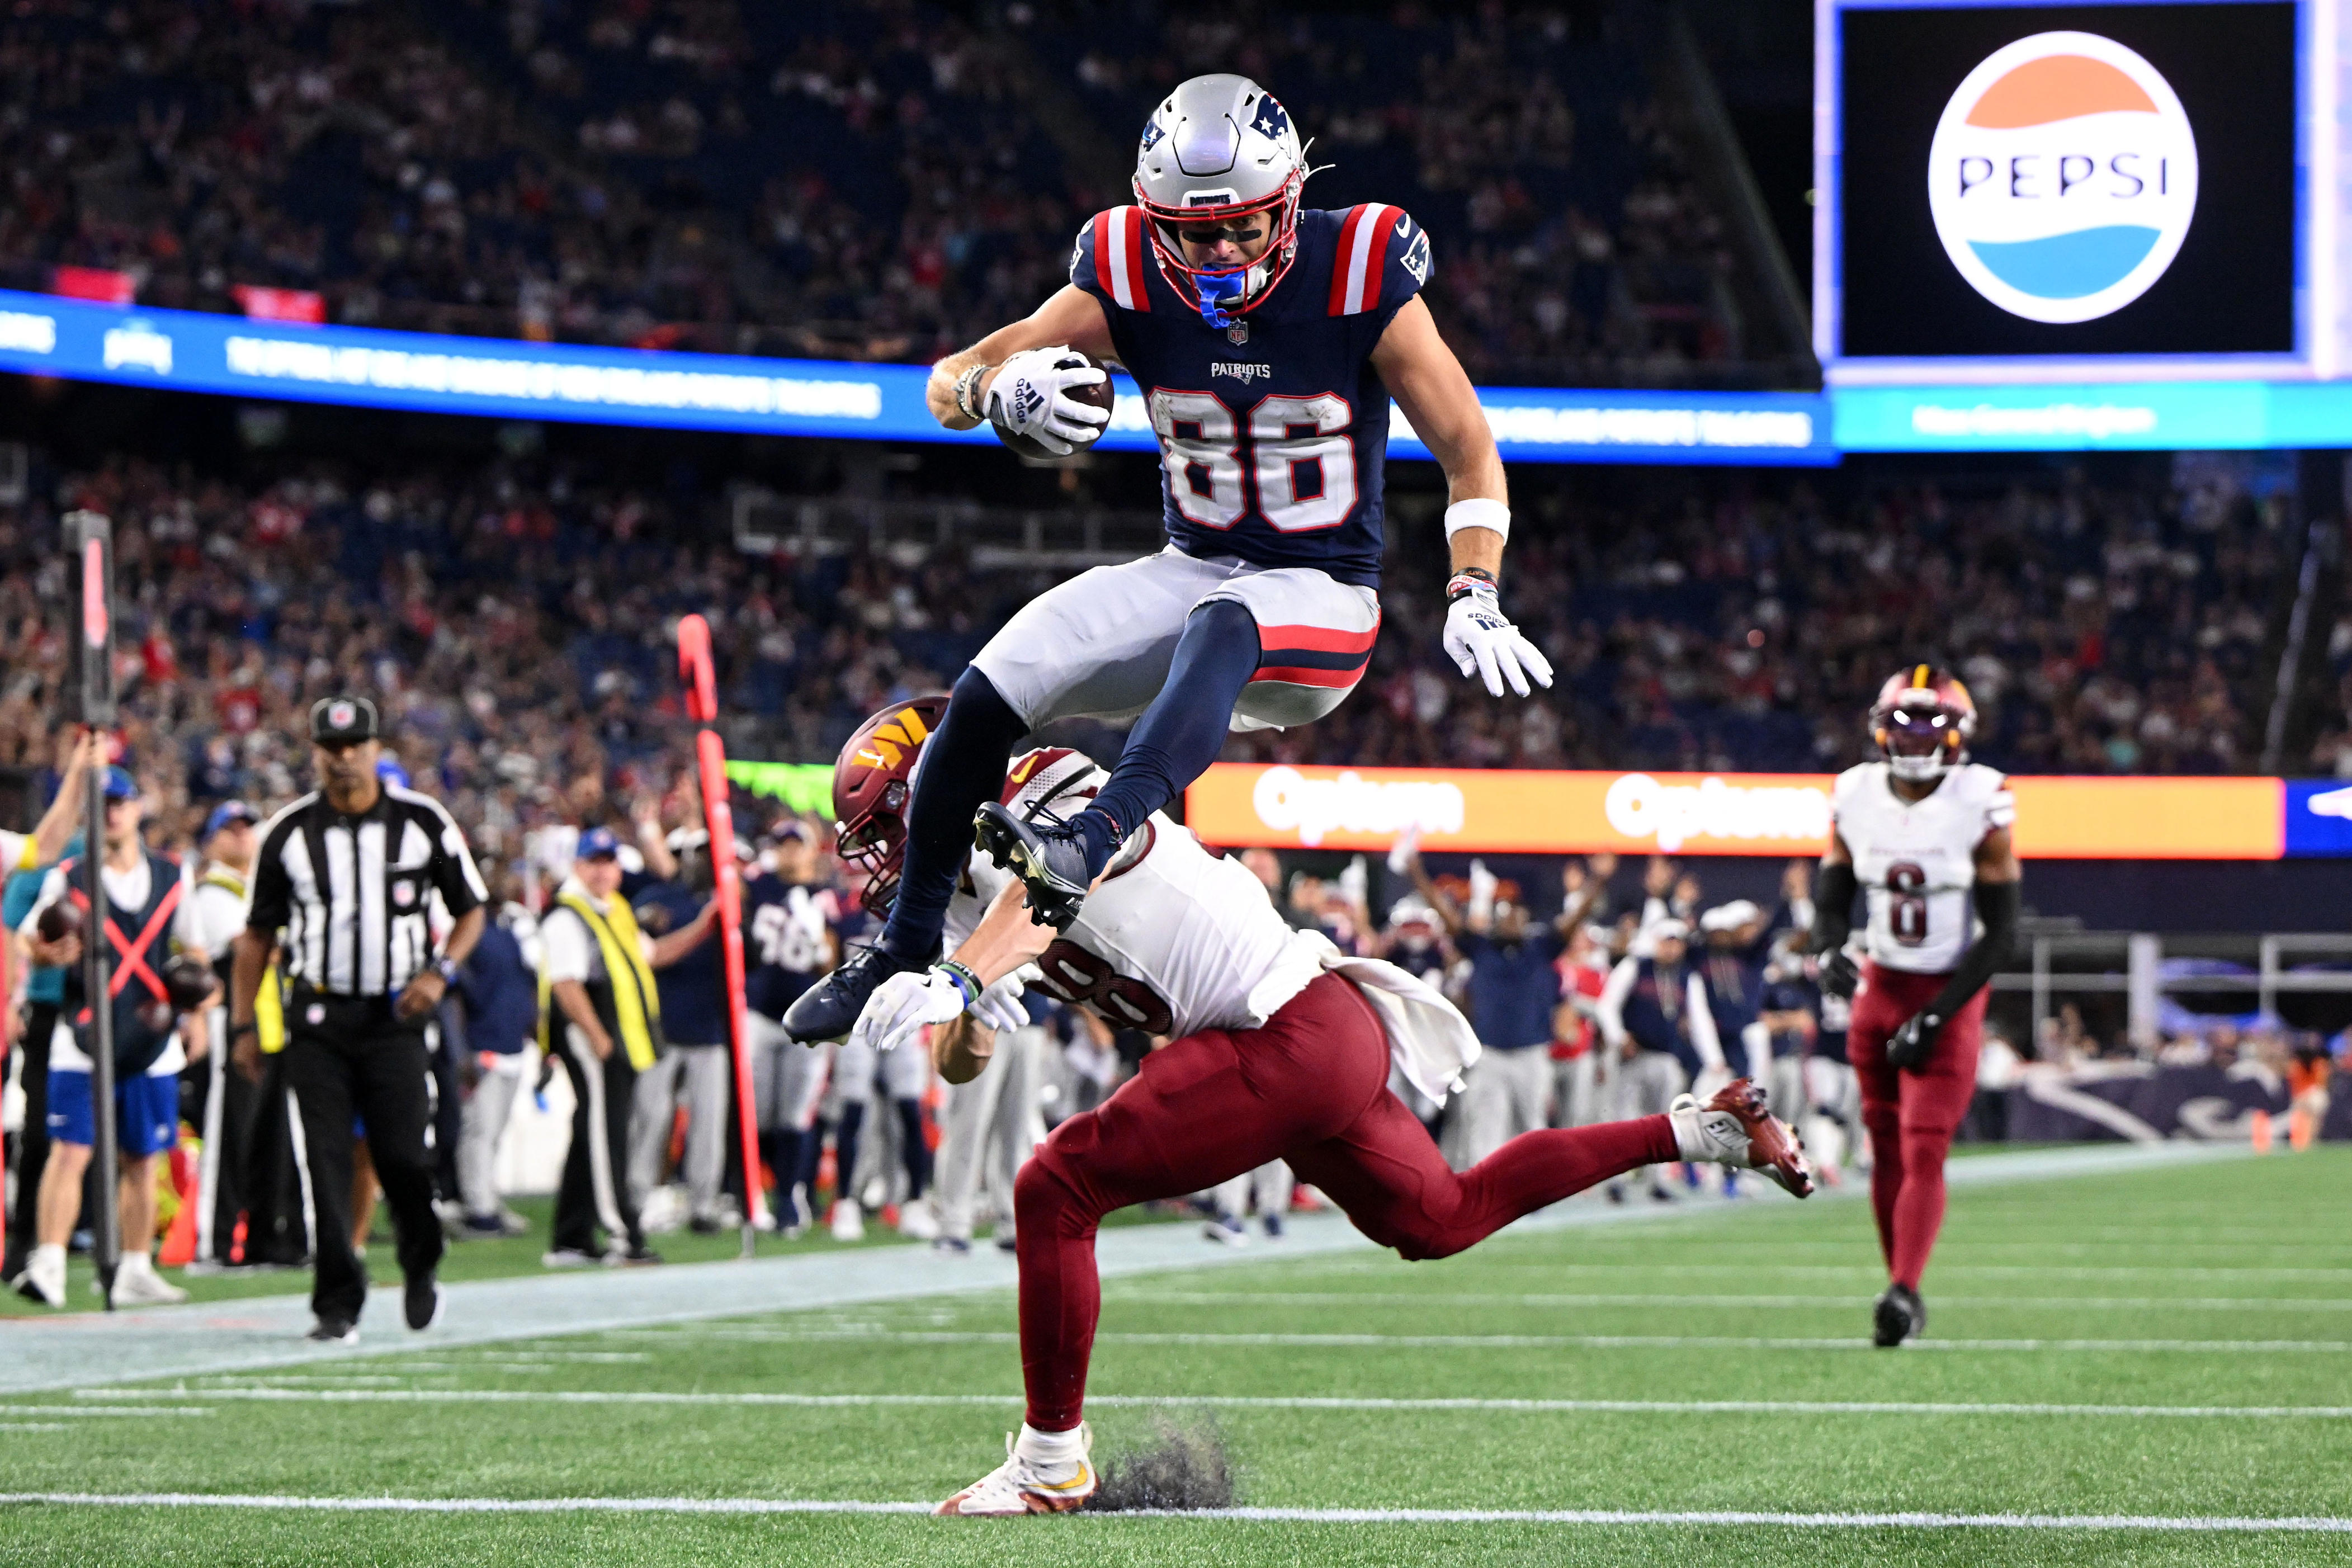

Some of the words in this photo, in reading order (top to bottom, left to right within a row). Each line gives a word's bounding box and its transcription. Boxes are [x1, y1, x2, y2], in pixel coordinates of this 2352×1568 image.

[1959, 152, 2167, 199] PEPSI
[1231, 330, 1245, 341] NFL
[1211, 362, 1271, 379] PATRIOTS
[1016, 378, 1026, 424] adidas
[1147, 386, 1359, 533] 86
